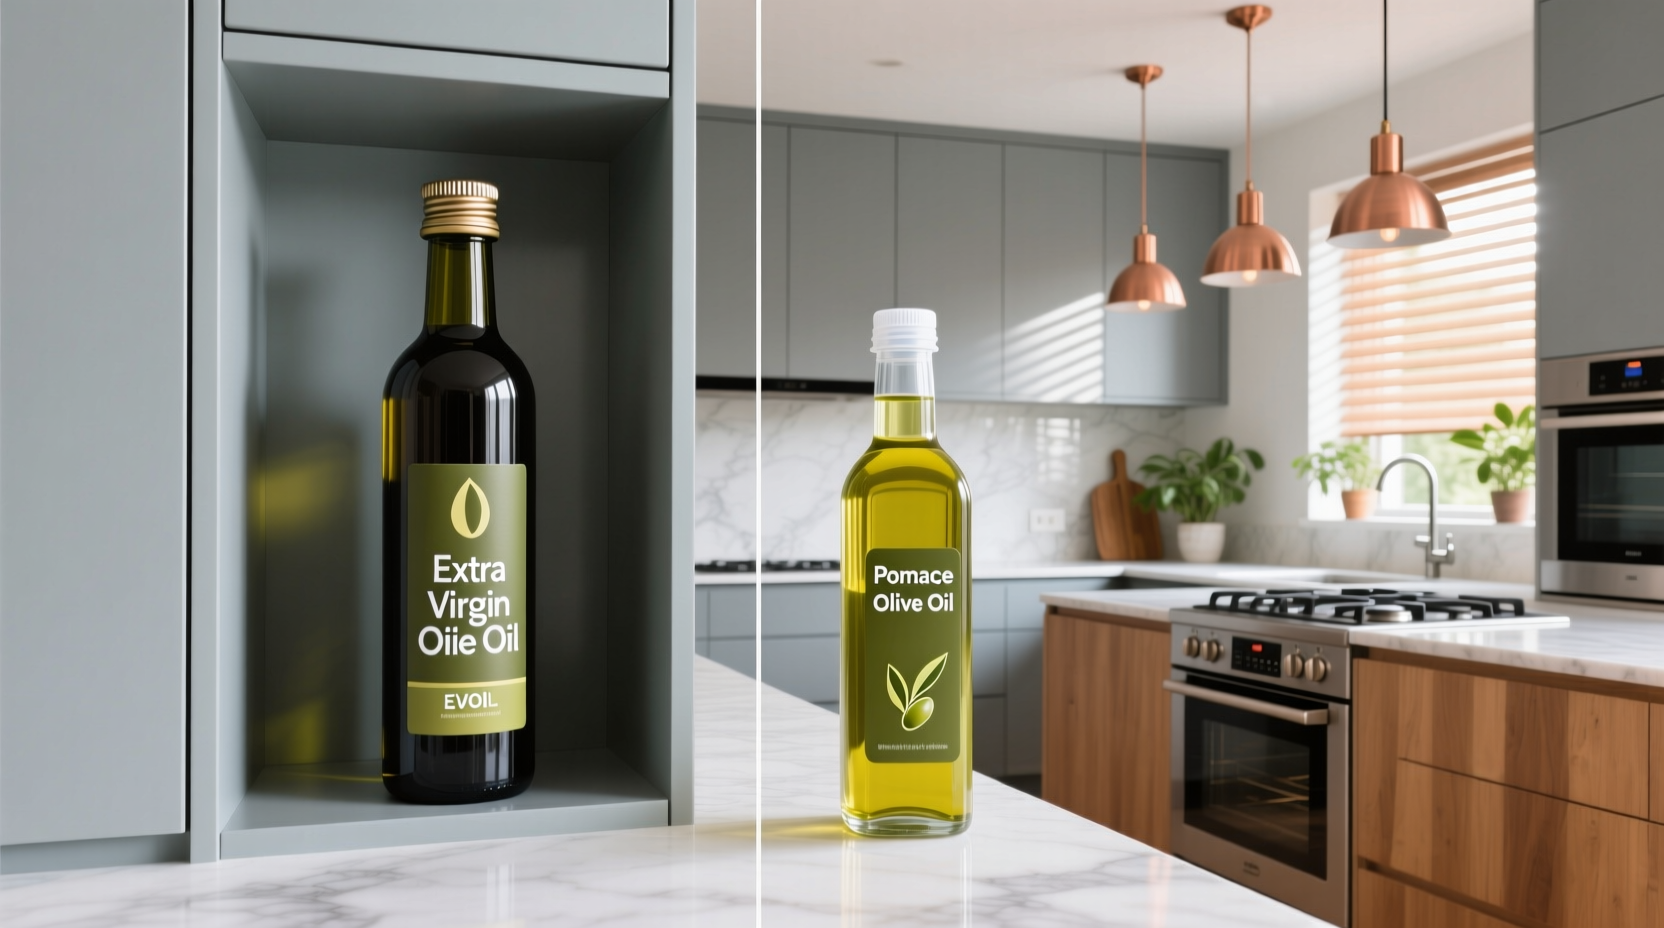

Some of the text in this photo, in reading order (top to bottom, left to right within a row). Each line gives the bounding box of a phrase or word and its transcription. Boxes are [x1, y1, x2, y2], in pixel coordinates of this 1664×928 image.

[433, 554, 506, 583] Extra
[874, 565, 954, 585] Pomace
[427, 590, 510, 627] Virgin
[873, 592, 954, 613] Olive Oil
[482, 622, 519, 654] Oil
[444, 691, 499, 710] EVOIL
